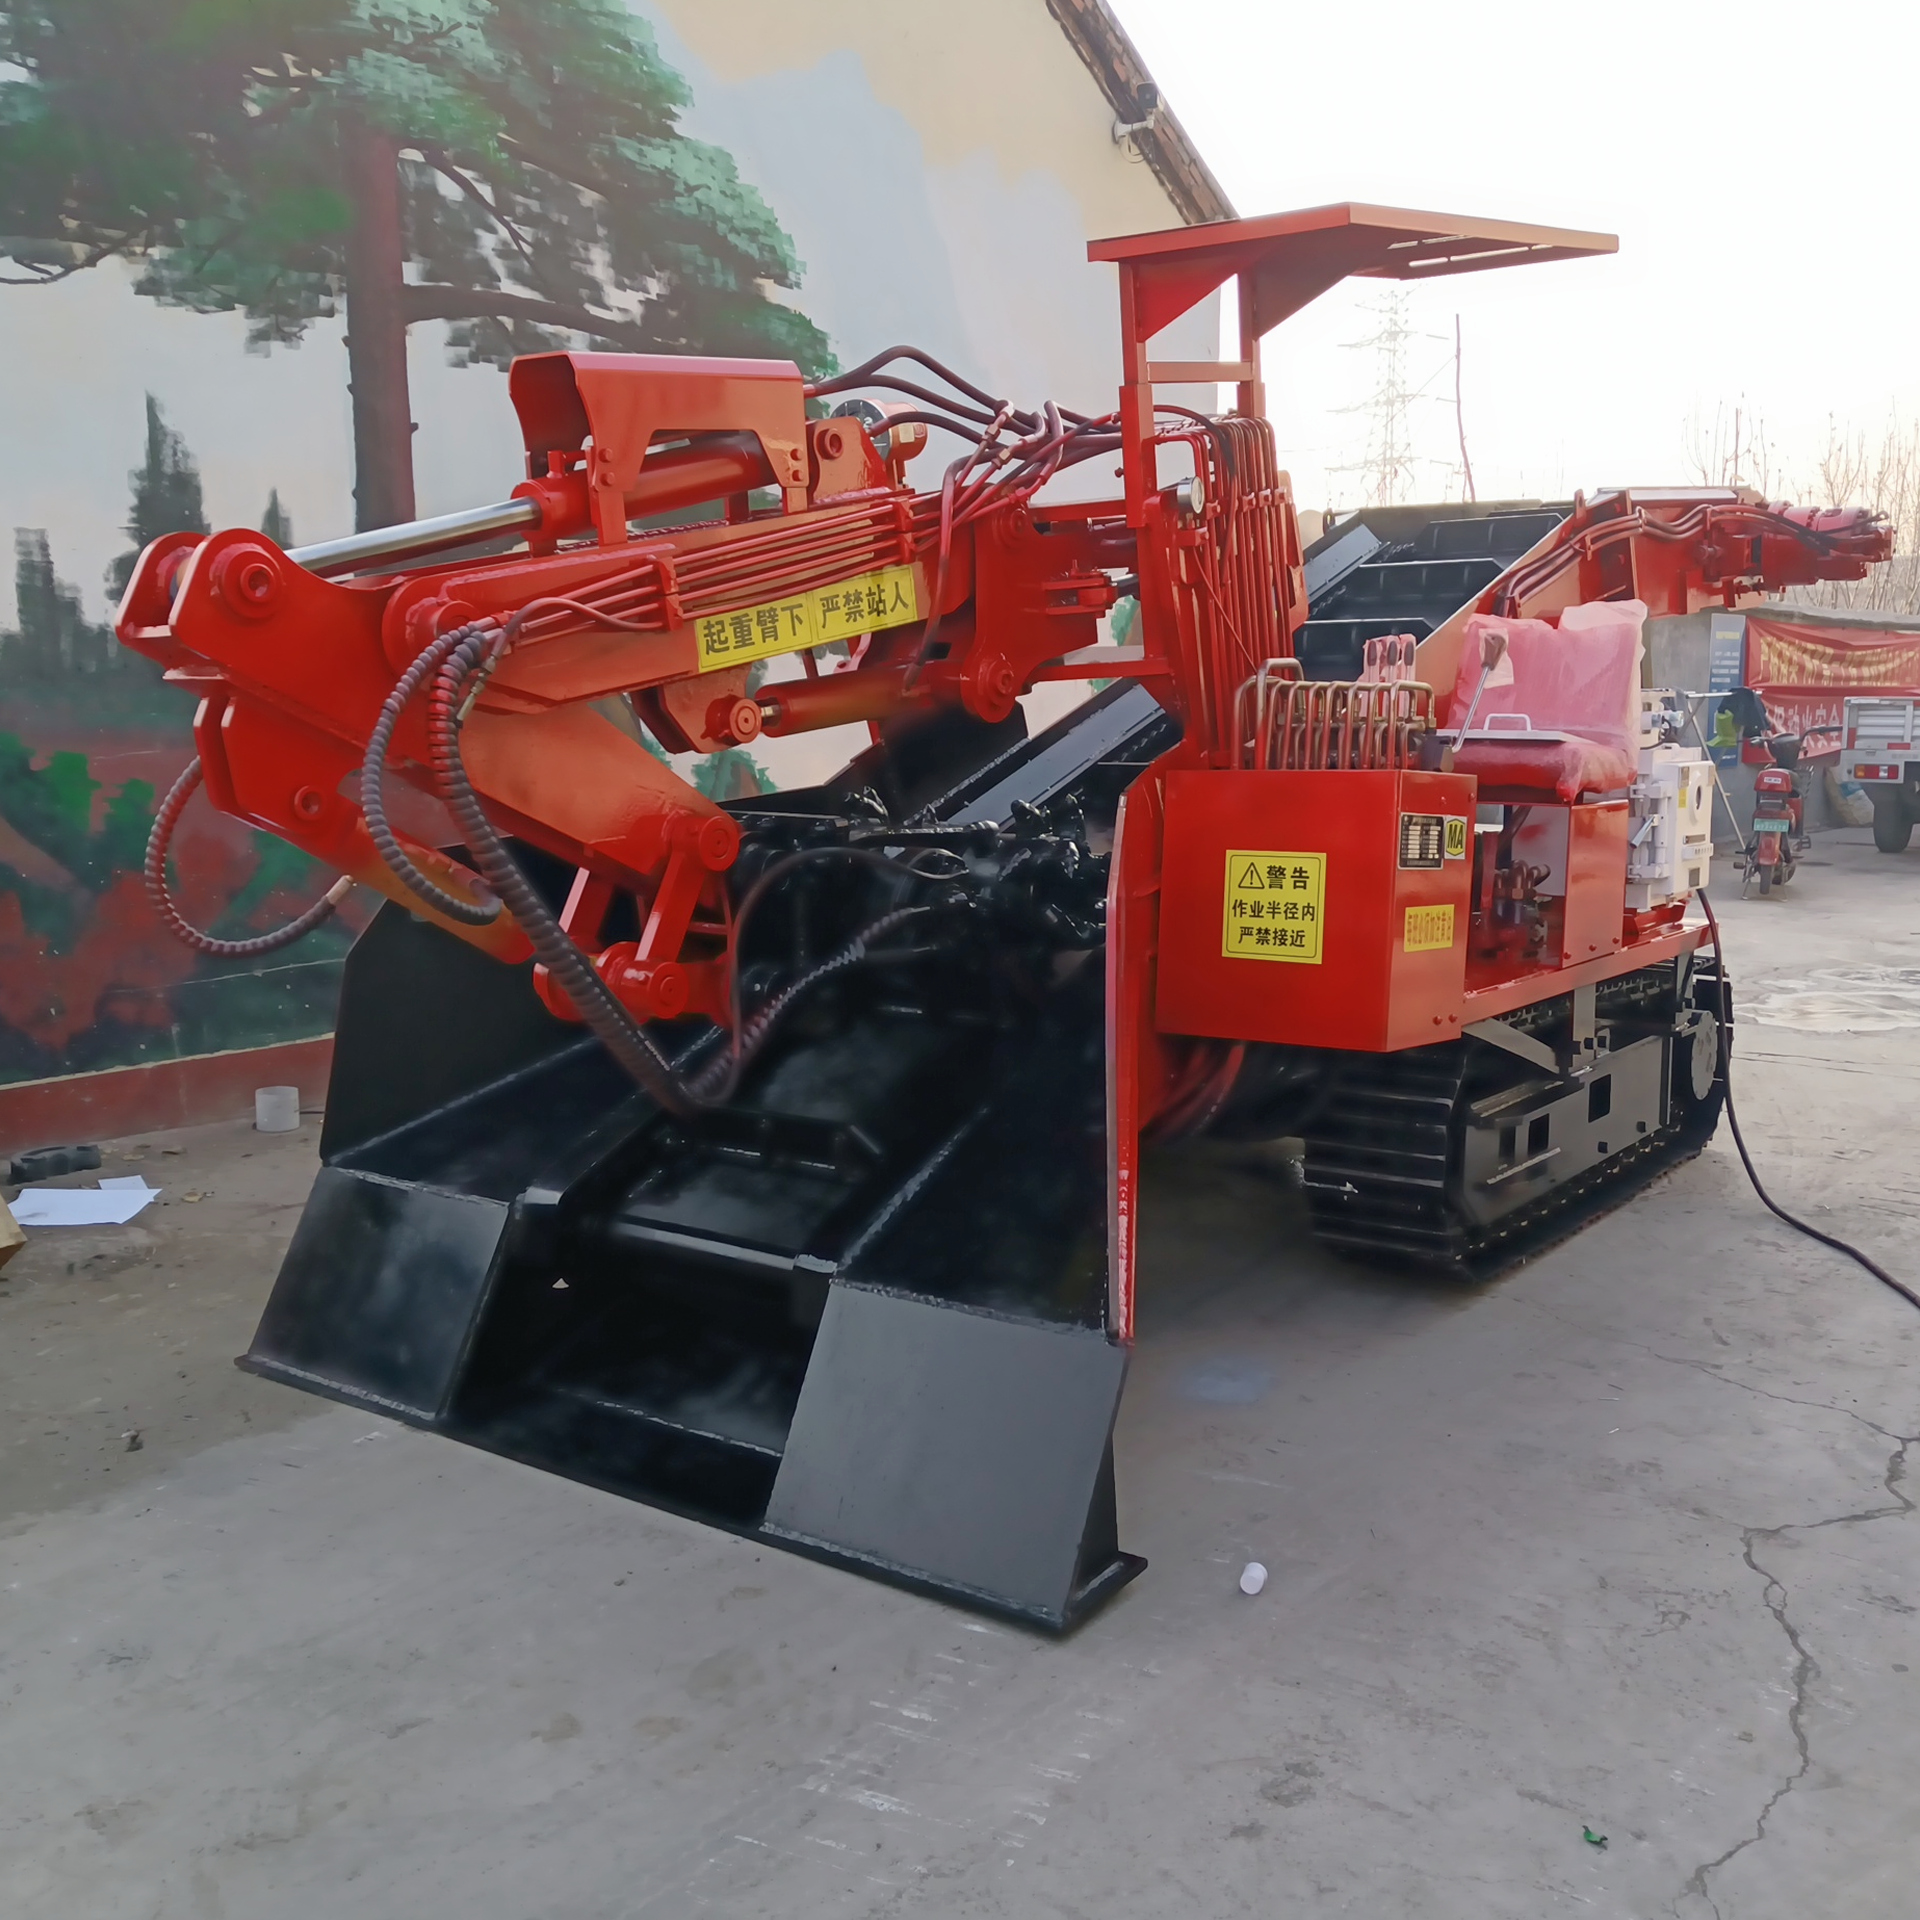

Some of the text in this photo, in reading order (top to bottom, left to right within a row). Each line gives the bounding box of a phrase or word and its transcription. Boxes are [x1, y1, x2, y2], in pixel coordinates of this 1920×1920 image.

[703, 581, 909, 655] 起重臂下 严禁站人
[1447, 823, 1464, 850] MA
[1266, 865, 1310, 890] 警告
[1232, 899, 1315, 922] 作业半径内
[1238, 926, 1306, 948] 严禁接近
